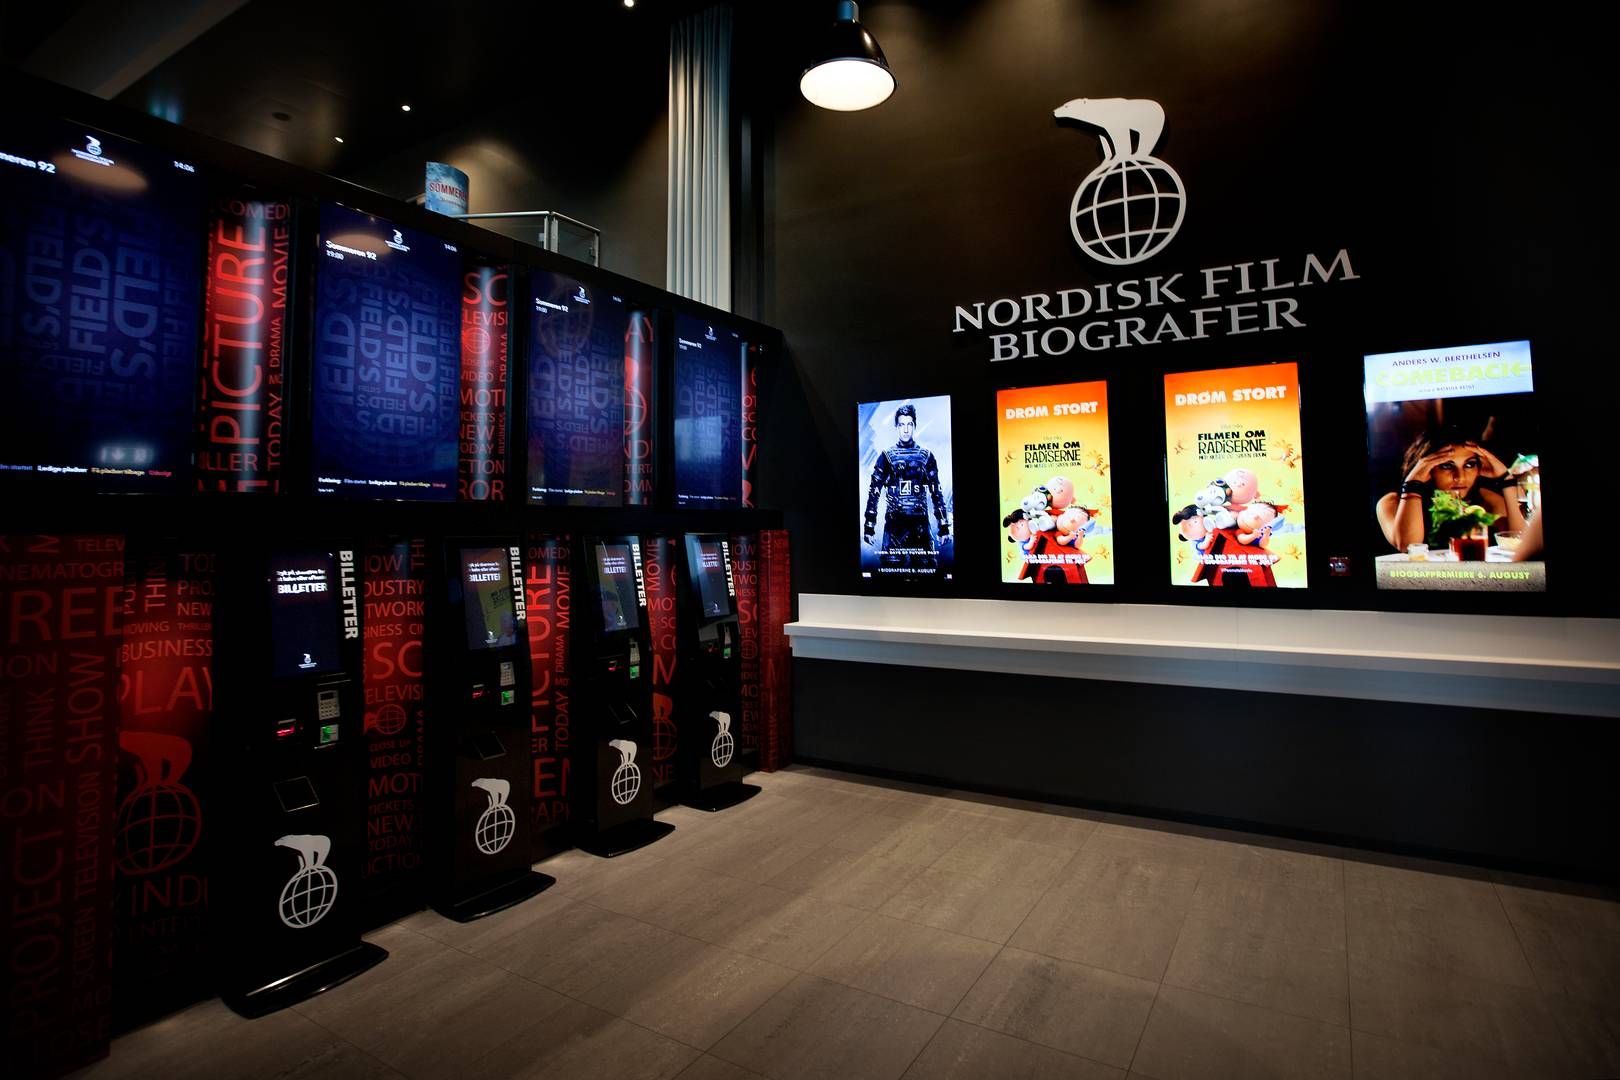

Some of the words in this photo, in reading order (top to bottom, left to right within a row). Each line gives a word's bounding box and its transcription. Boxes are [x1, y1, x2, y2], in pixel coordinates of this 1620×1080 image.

[37, 160, 57, 174] 92
[271, 226, 290, 310] MOVIE
[952, 273, 1185, 333] NORDISK
[1199, 249, 1361, 300] FILM
[209, 218, 267, 447] PICTURE
[989, 297, 1307, 363] BIOGRAFER
[1392, 358, 1428, 368] ANDERS
[1444, 351, 1502, 364] BERTHELSEN
[1376, 361, 1523, 387] COMEBACK
[1053, 401, 1098, 416] STORT
[1175, 391, 1228, 407] DRØM
[1232, 385, 1288, 402] STORT
[266, 391, 284, 472] TODAY
[1197, 432, 1240, 442] FILMEN
[1244, 430, 1266, 439] OM
[1024, 443, 1059, 452] FILMEN
[1063, 441, 1081, 449] OM
[631, 543, 647, 608] BILLETTER
[721, 540, 737, 598] BILLETTER
[1390, 570, 1475, 579] BIOGRAFPREMIERE
[1489, 571, 1531, 581] AUGUST
[277, 582, 328, 594] BILLETTER
[338, 549, 360, 641] BILLETTER
[508, 545, 527, 621] BILLETTER
[556, 564, 571, 630] MOVIE
[121, 639, 214, 663] BUSINESS
[65, 650, 106, 766] SHOW
[368, 752, 413, 769] VIDEO
[367, 814, 416, 841] NEW
